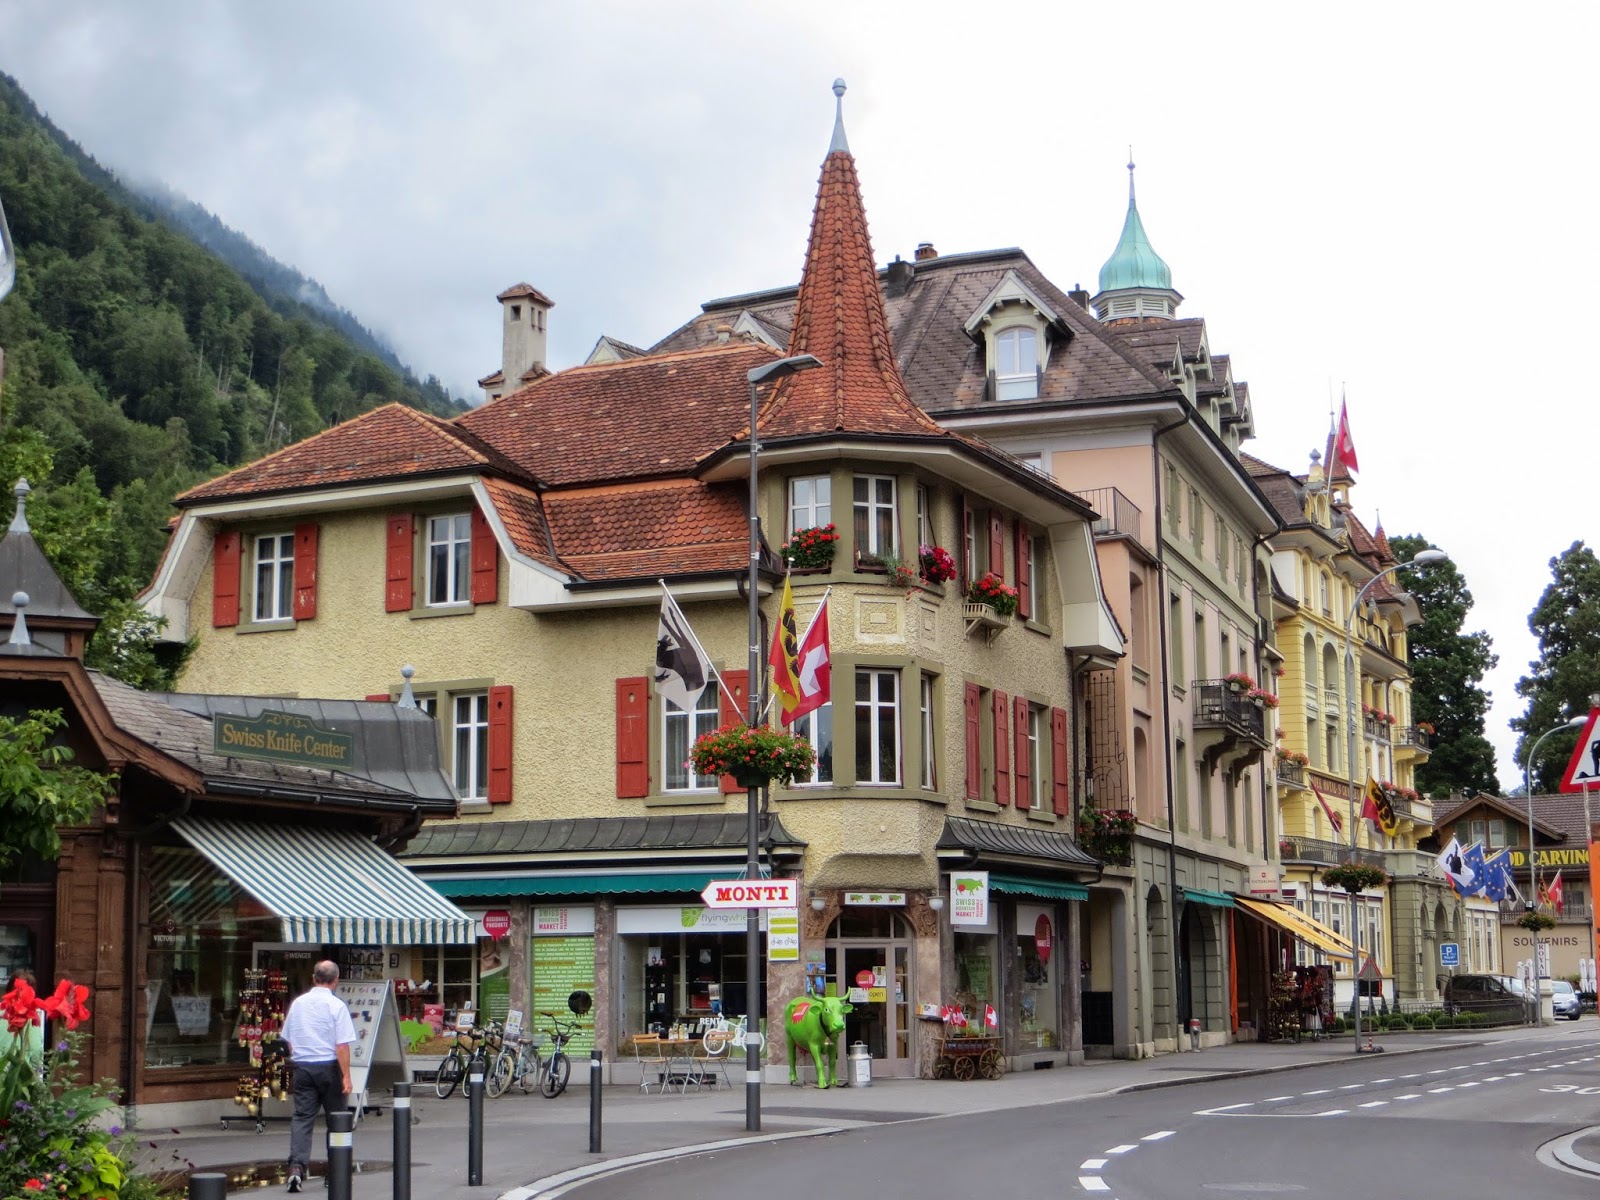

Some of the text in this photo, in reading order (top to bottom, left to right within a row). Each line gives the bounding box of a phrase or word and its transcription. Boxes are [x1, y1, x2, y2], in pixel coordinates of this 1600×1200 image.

[222, 723, 347, 759] Swiss Knife Center
[716, 886, 788, 902] MONTI
[955, 898, 976, 906] SWISS
[538, 908, 560, 917] SWISS
[153, 934, 187, 942] VICTORINOX
[700, 1017, 720, 1025] RENT
